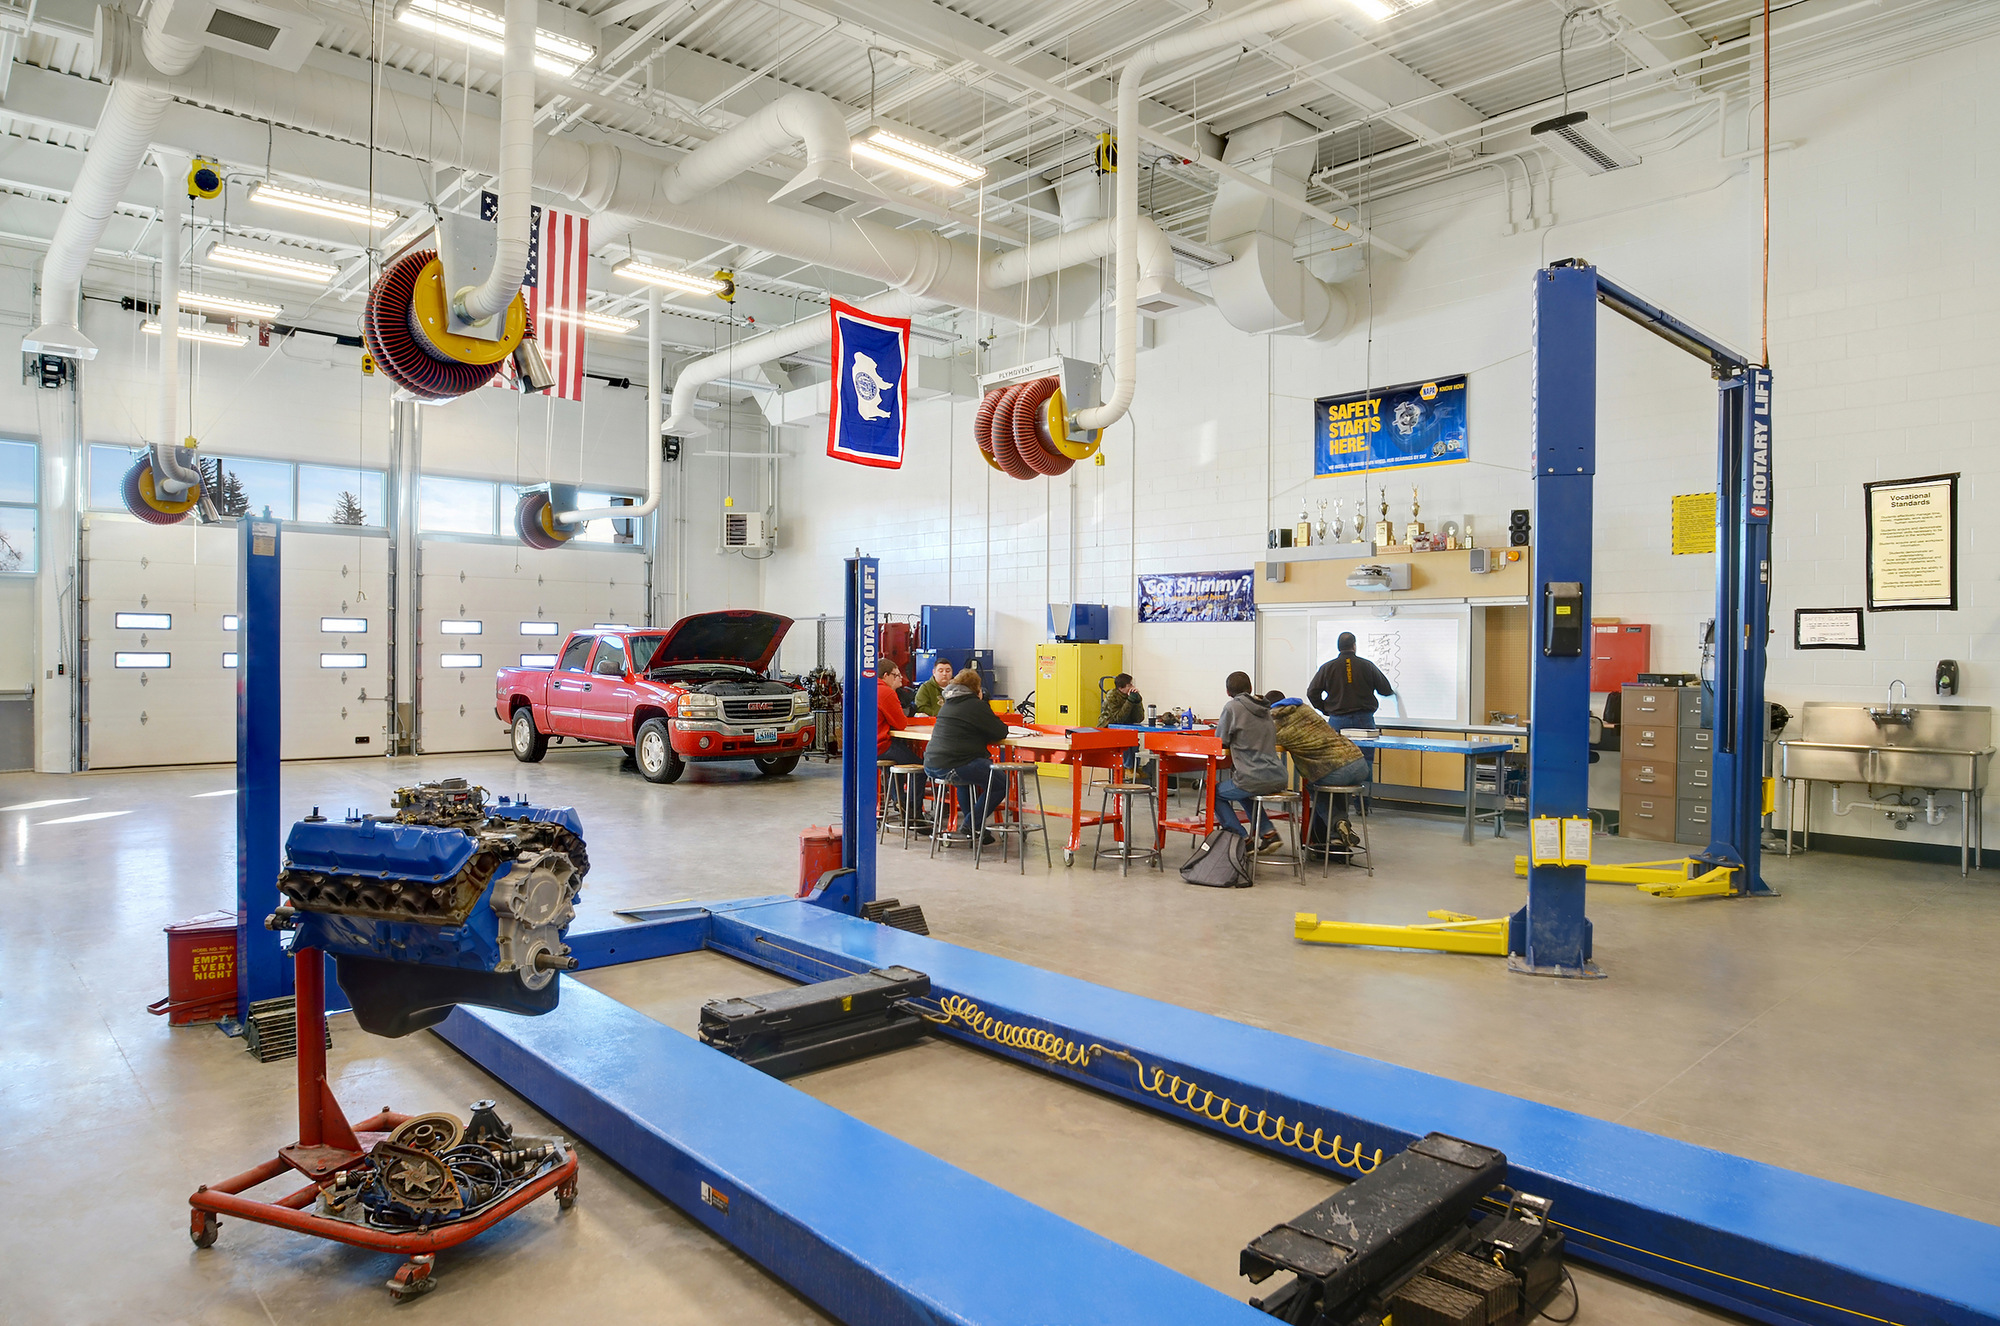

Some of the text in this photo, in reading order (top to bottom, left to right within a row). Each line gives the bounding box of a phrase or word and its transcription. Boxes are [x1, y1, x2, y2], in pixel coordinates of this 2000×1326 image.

[998, 366, 1034, 379] PLYMOVENT
[1422, 387, 1436, 397] NAPA
[1328, 398, 1381, 421] SAFETY
[1329, 416, 1381, 438] STARTS
[1752, 371, 1770, 505] ROTARY LIFT
[1329, 436, 1369, 455] HERE.
[1890, 492, 1931, 501] Vocational
[1891, 499, 1931, 508] Standards
[1145, 575, 1250, 596] Got Shimmy?
[864, 565, 876, 668] ROTARY LIFT
[748, 702, 774, 711] GMC
[193, 954, 233, 965] EMPTY
[192, 962, 234, 972] EVERY
[194, 970, 232, 980] NIGHT
